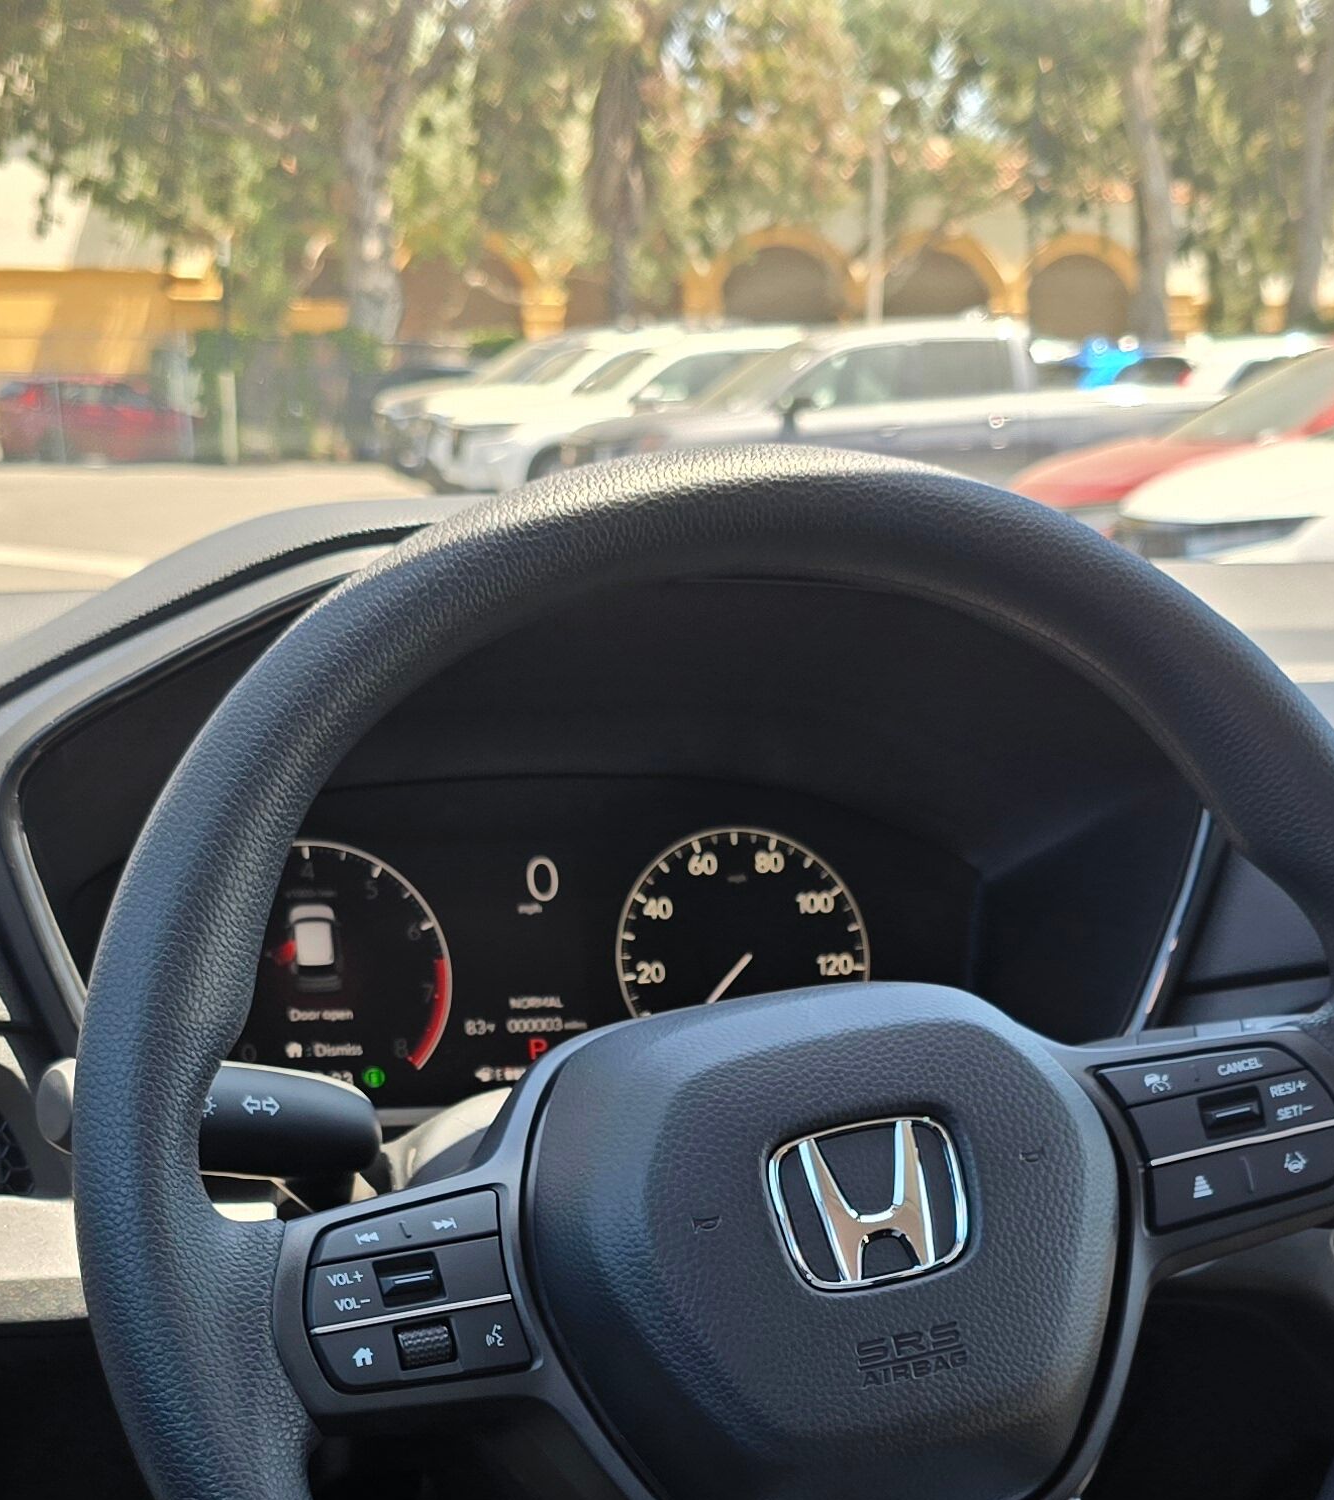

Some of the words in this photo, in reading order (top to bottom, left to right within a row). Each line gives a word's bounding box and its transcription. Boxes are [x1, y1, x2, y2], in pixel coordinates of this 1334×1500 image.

[687, 851, 718, 876] 60
[754, 850, 785, 874] 80
[526, 855, 559, 902] 0
[642, 896, 673, 920] 40
[796, 890, 835, 915] 100
[635, 960, 666, 984] 20
[816, 953, 855, 976] 120
[508, 995, 565, 1010] NORMAL
[288, 1007, 320, 1022] Door
[321, 1009, 354, 1023] open
[312, 1042, 364, 1058] Dismiss
[528, 1037, 549, 1061] P
[1217, 1056, 1264, 1077] CANCEL
[1269, 1079, 1308, 1099] RES/+
[1275, 1103, 1315, 1122] SET/-
[326, 1270, 364, 1288] VOL+
[854, 1320, 961, 1367] SRS
[861, 1349, 967, 1390] AIRBAG
